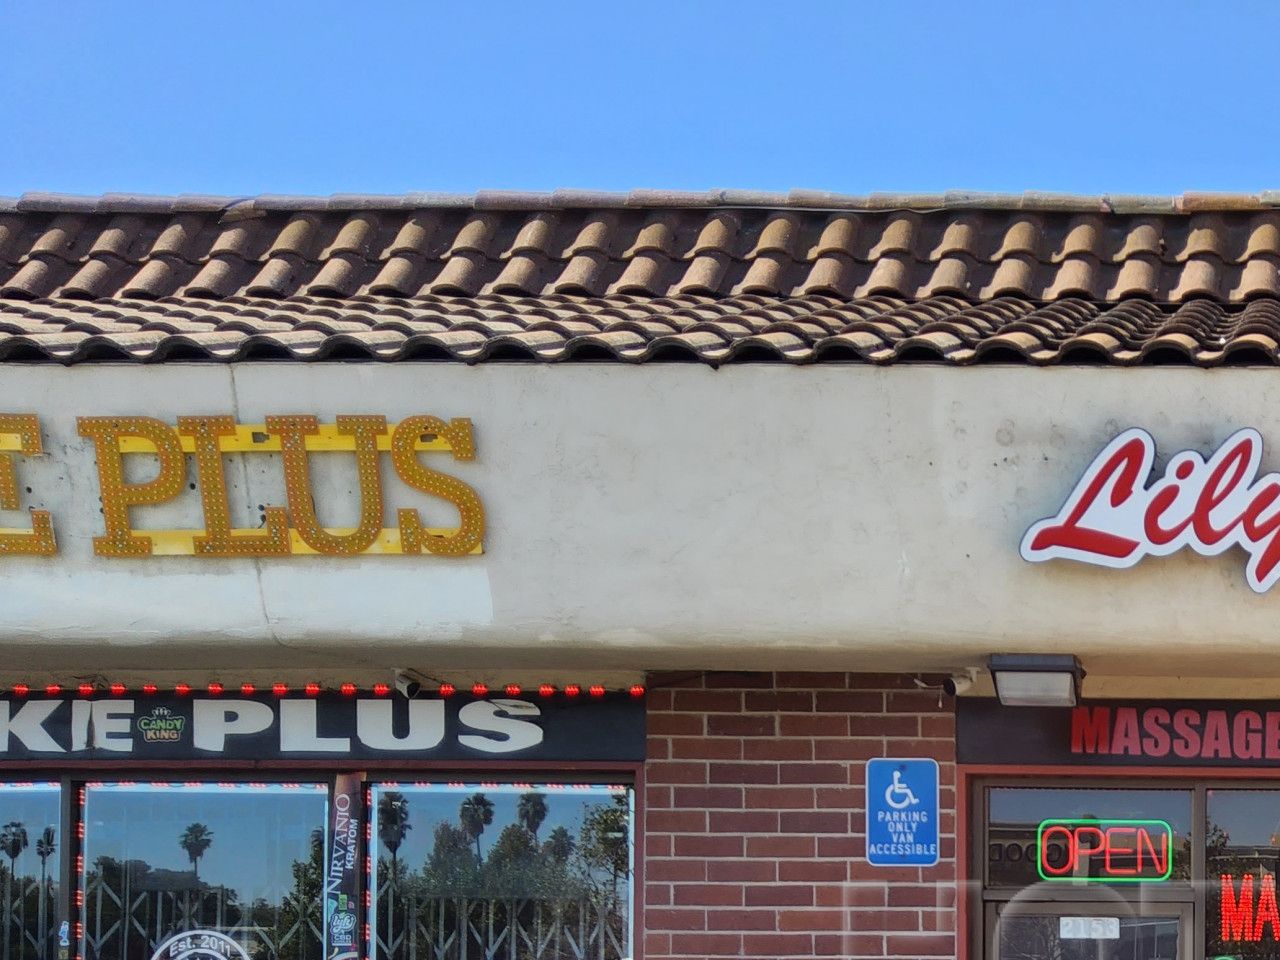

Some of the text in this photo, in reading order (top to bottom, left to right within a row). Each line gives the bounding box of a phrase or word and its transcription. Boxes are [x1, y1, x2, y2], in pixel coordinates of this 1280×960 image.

[76, 413, 486, 558] PLUS
[139, 716, 184, 731] CANDY
[193, 699, 544, 754] PLUS
[144, 729, 180, 742] KING
[877, 811, 929, 822] PARKING
[887, 821, 918, 832] ONLY
[345, 818, 358, 870] KRATOM
[892, 832, 914, 843] VAN
[869, 843, 937, 855] ACCESSIBLE
[1041, 825, 1168, 875] OPEN
[169, 935, 231, 957] Est. 2011
